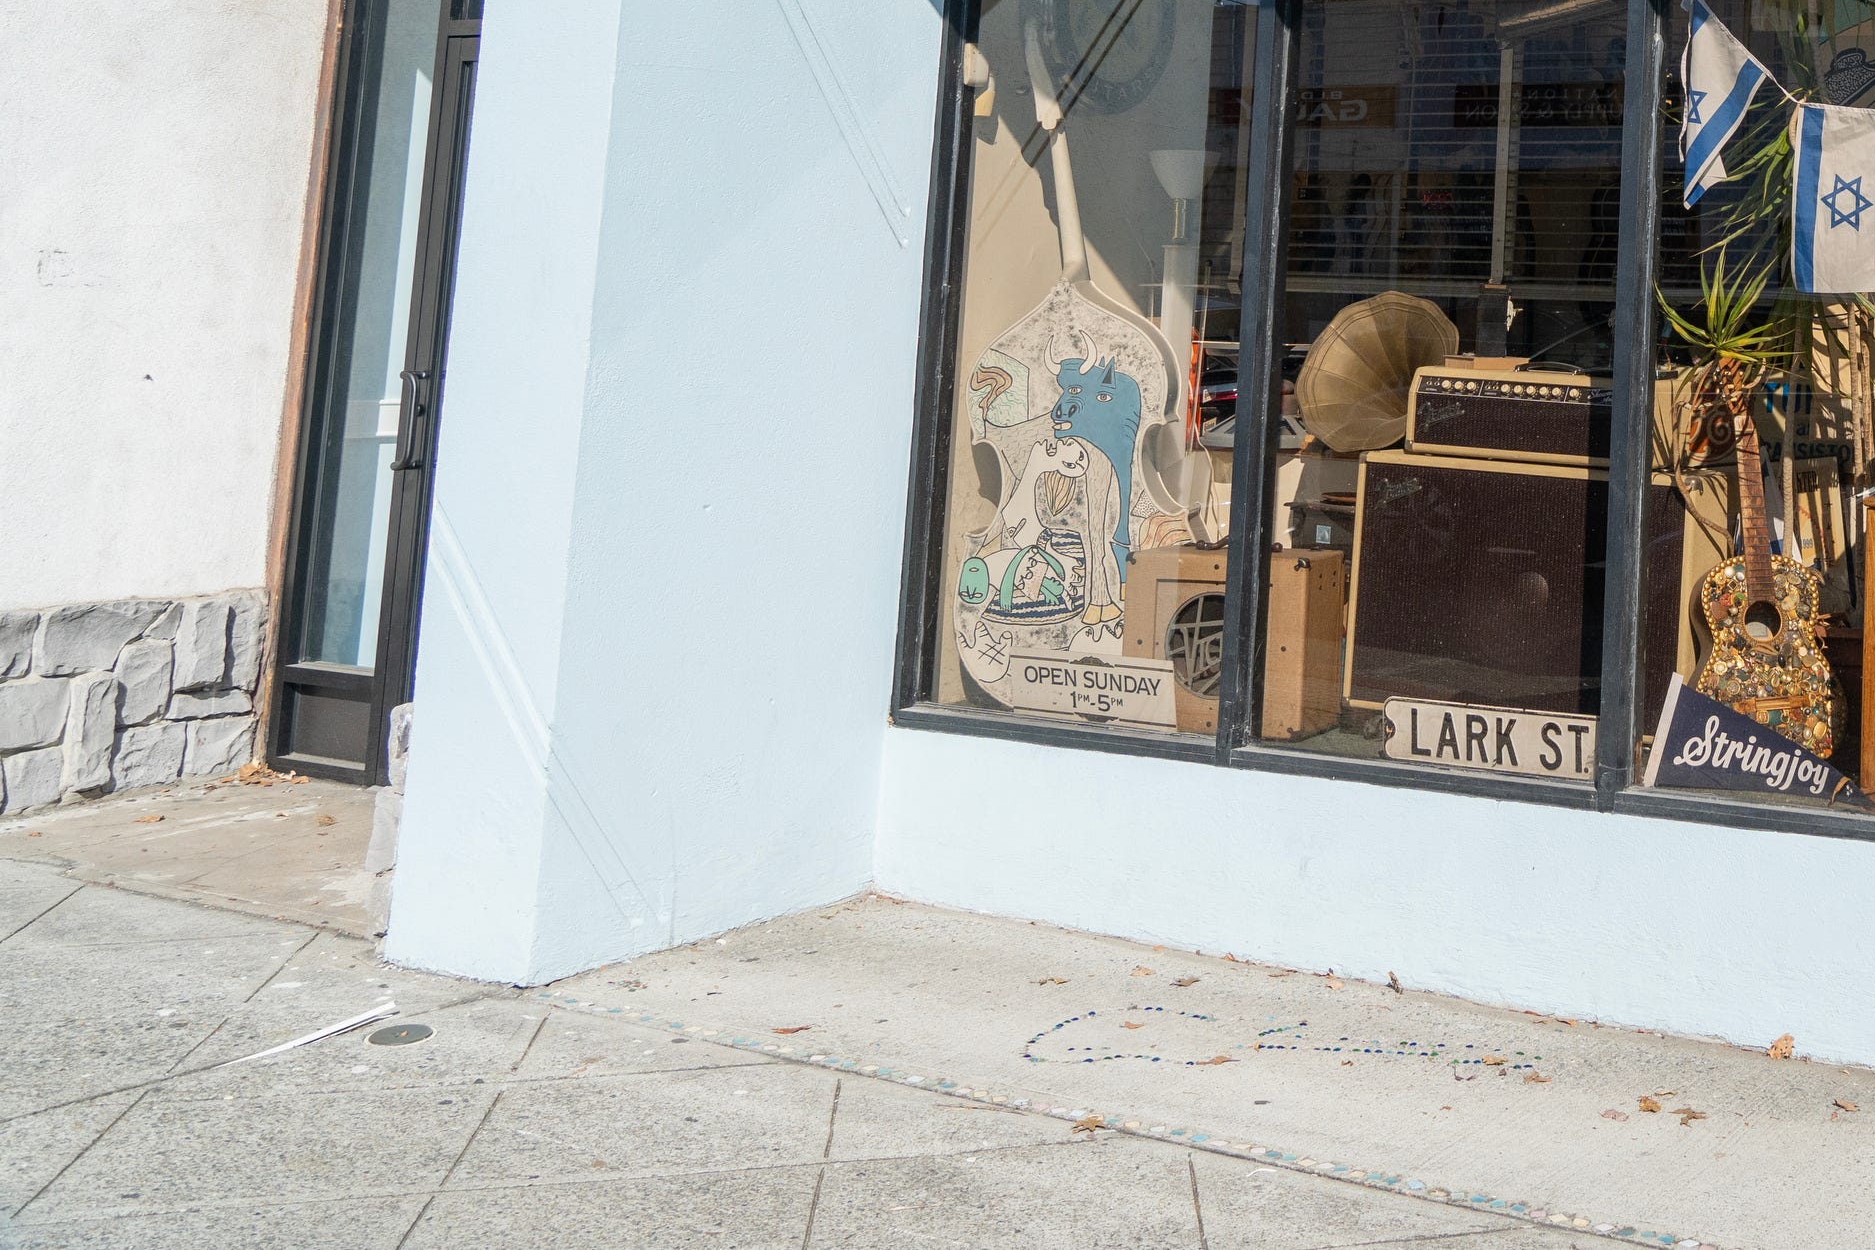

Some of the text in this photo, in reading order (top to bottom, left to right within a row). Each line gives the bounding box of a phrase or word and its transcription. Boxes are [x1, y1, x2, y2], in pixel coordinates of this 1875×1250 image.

[1024, 665, 1161, 697] OPEN SUNDAY
[1410, 707, 1590, 774] LARK ST.
[1673, 715, 1830, 795] Stringjoy
